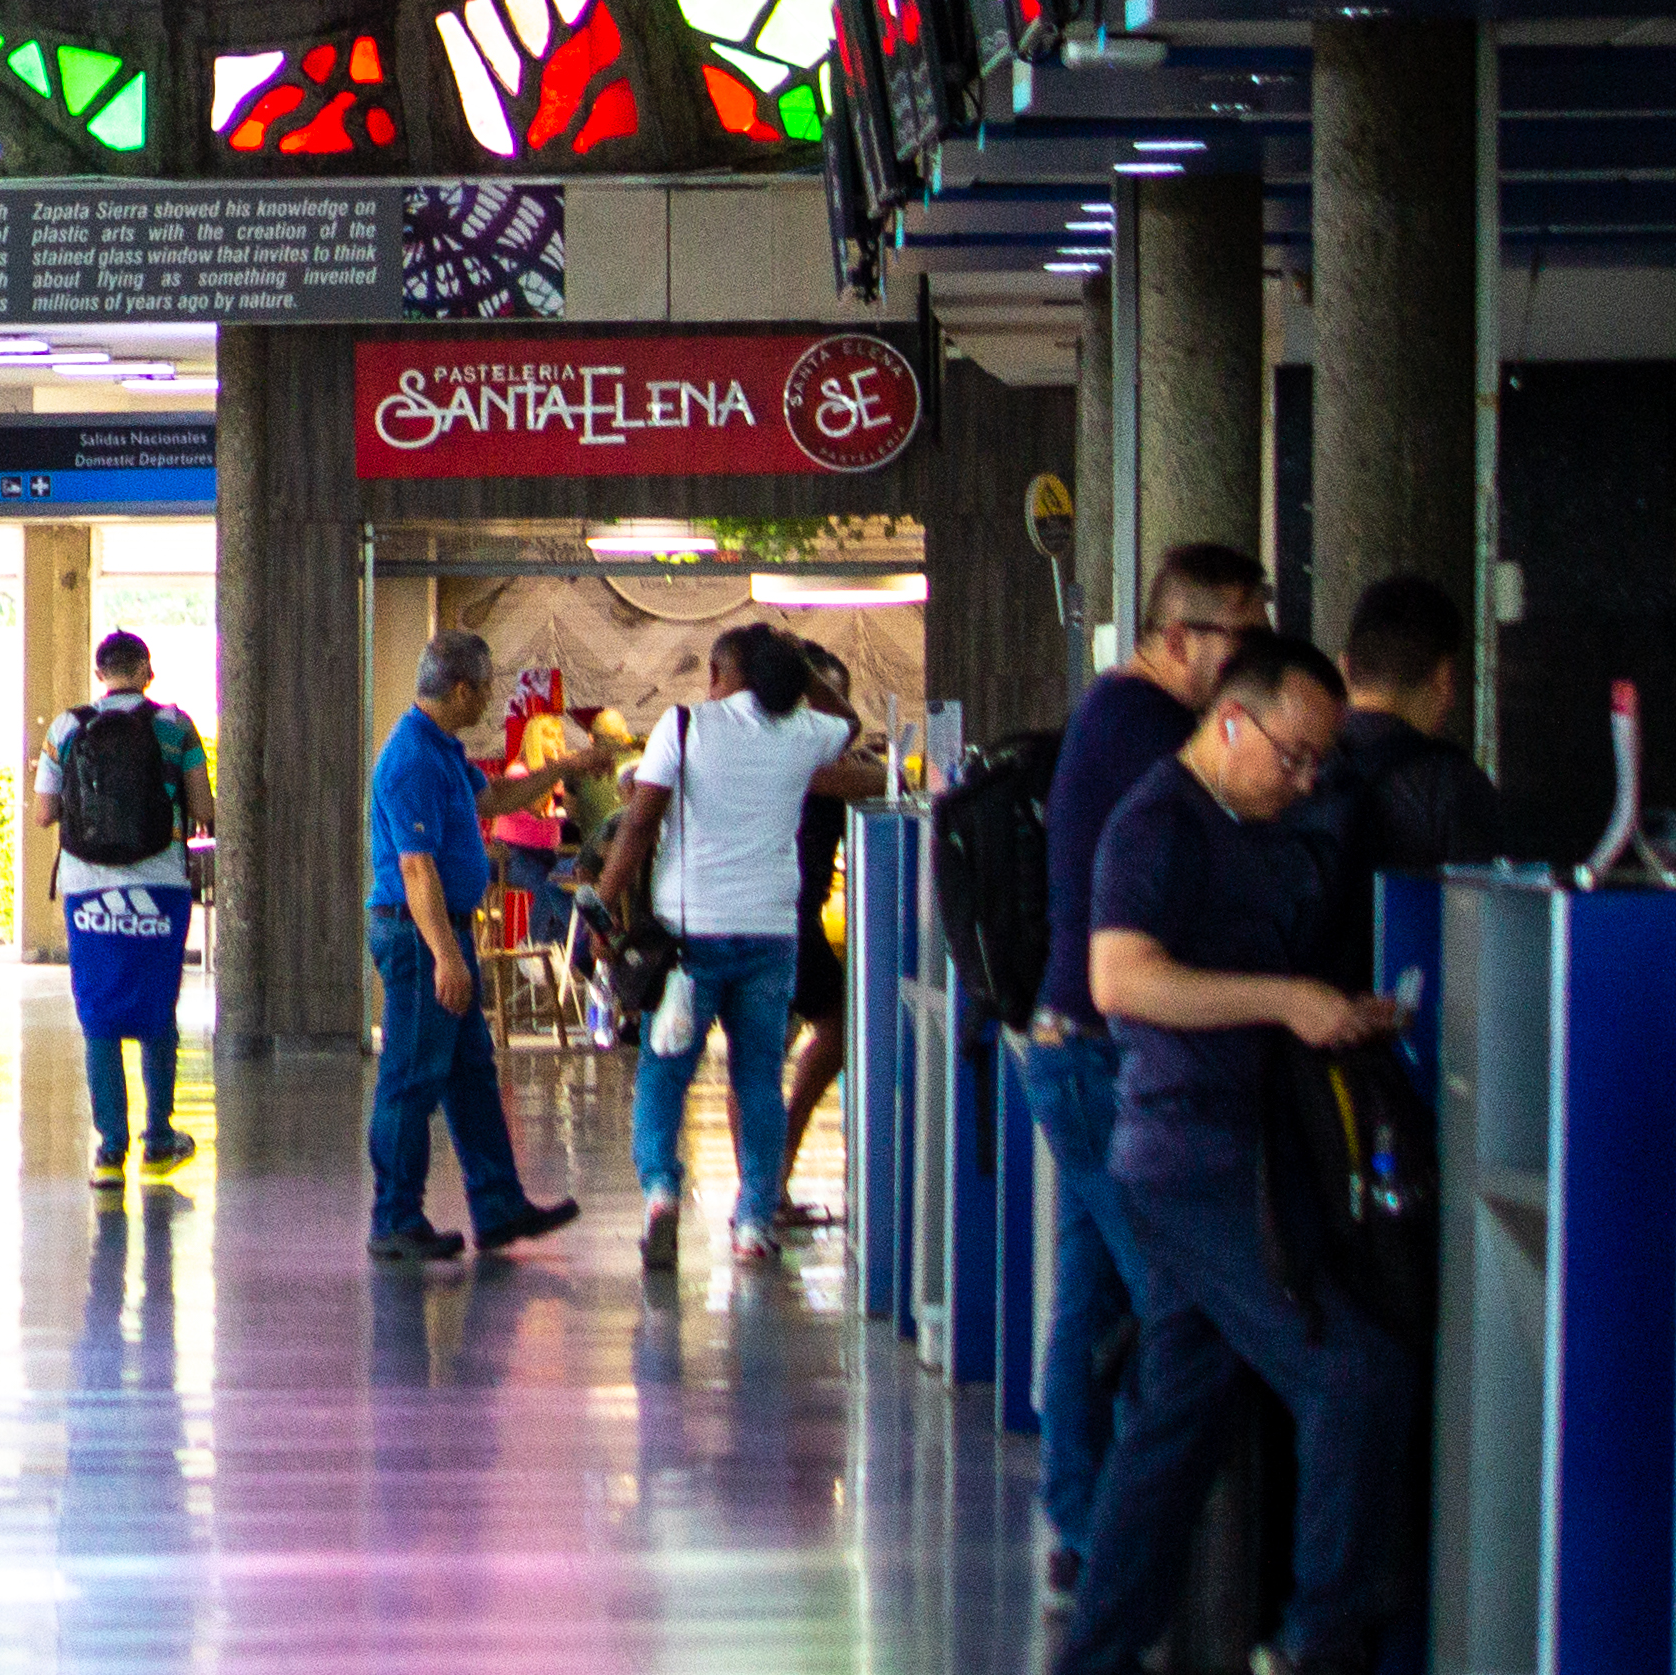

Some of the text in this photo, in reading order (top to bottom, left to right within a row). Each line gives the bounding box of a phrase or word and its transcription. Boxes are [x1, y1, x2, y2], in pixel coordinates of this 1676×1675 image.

[31, 268, 378, 293] about flying as something invented
[434, 363, 576, 384] PASTELERIA
[788, 341, 903, 407] SANTA ELENA
[80, 430, 208, 447] Salidas Nacionales
[75, 451, 213, 469] Domestic Departures
[73, 909, 171, 937] adidas
